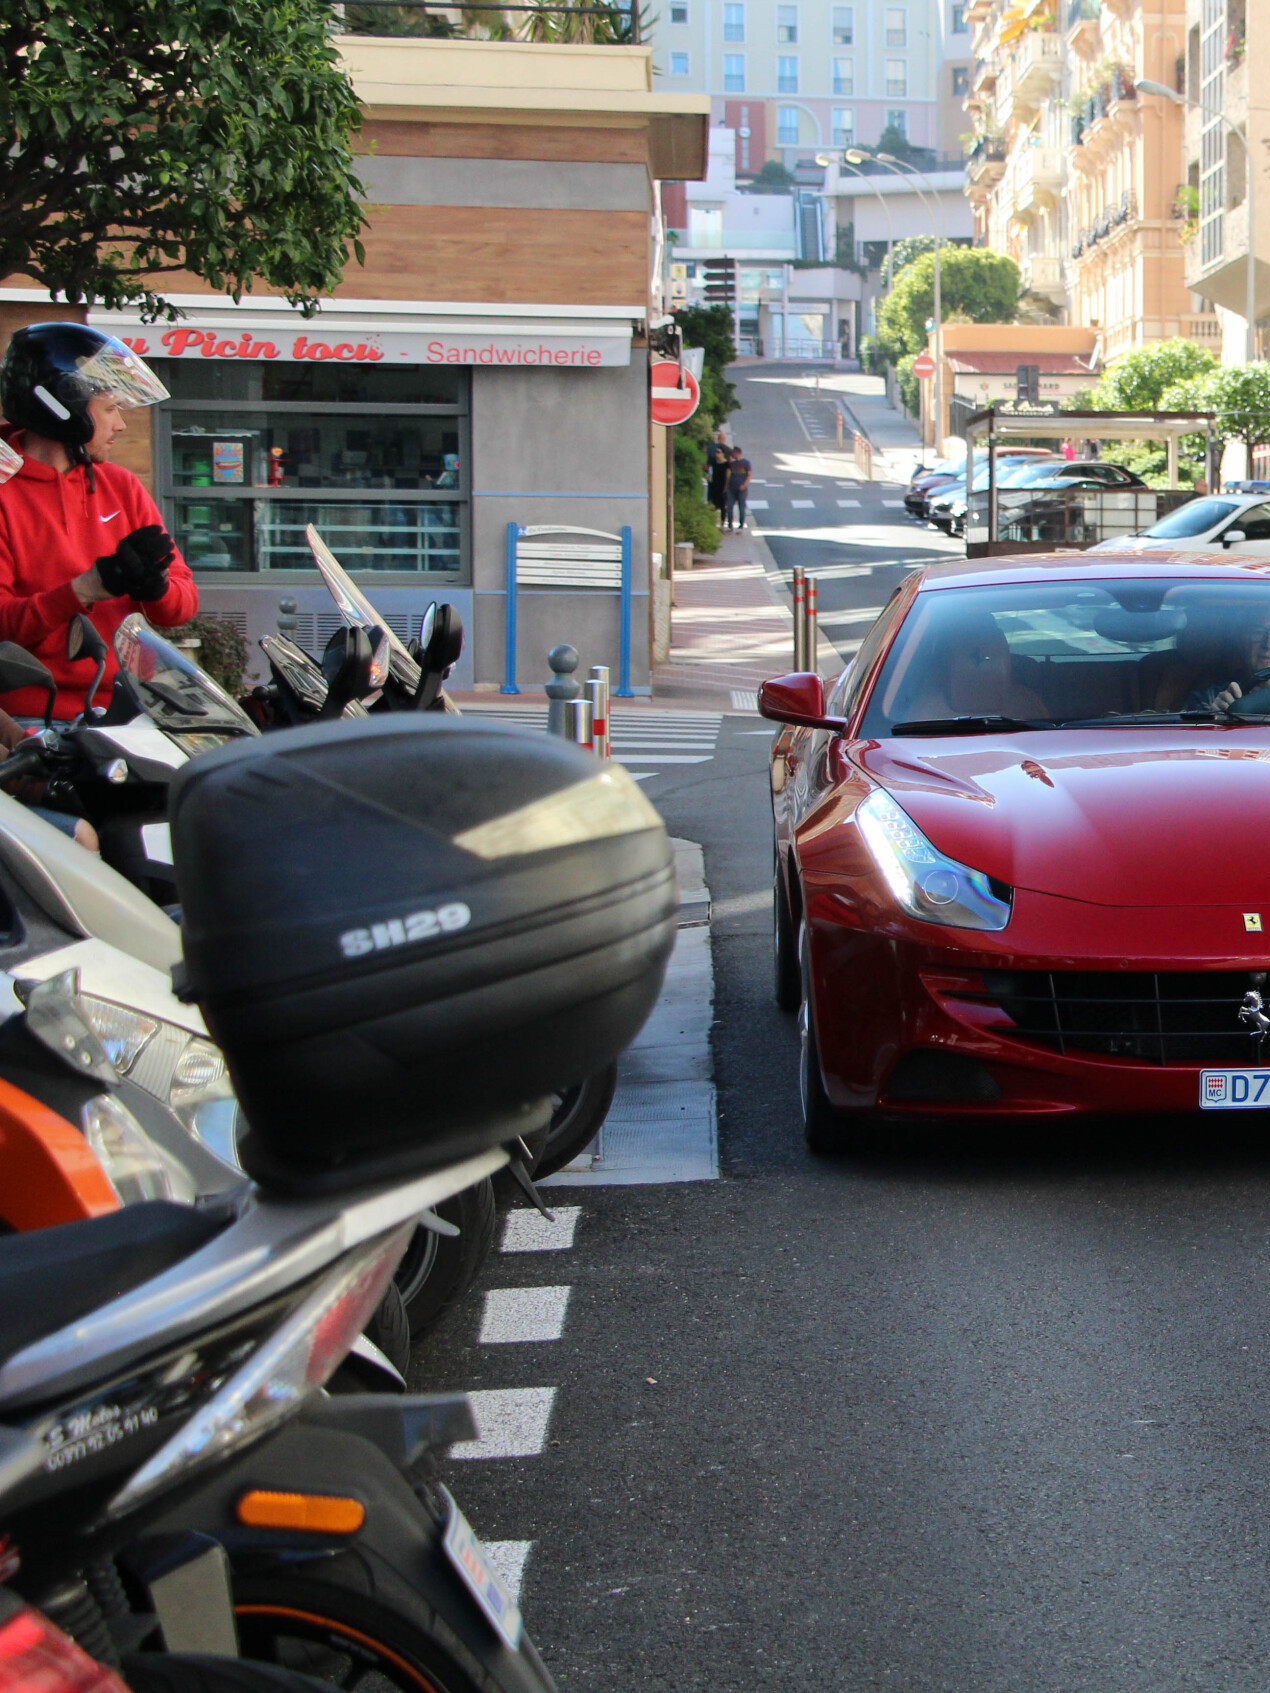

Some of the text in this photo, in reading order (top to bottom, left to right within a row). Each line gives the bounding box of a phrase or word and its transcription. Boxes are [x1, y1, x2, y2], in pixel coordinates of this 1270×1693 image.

[161, 328, 280, 359] Picin
[426, 341, 602, 366] Sandwicherie
[340, 902, 471, 956] SH29
[1208, 1089, 1222, 1097] MC
